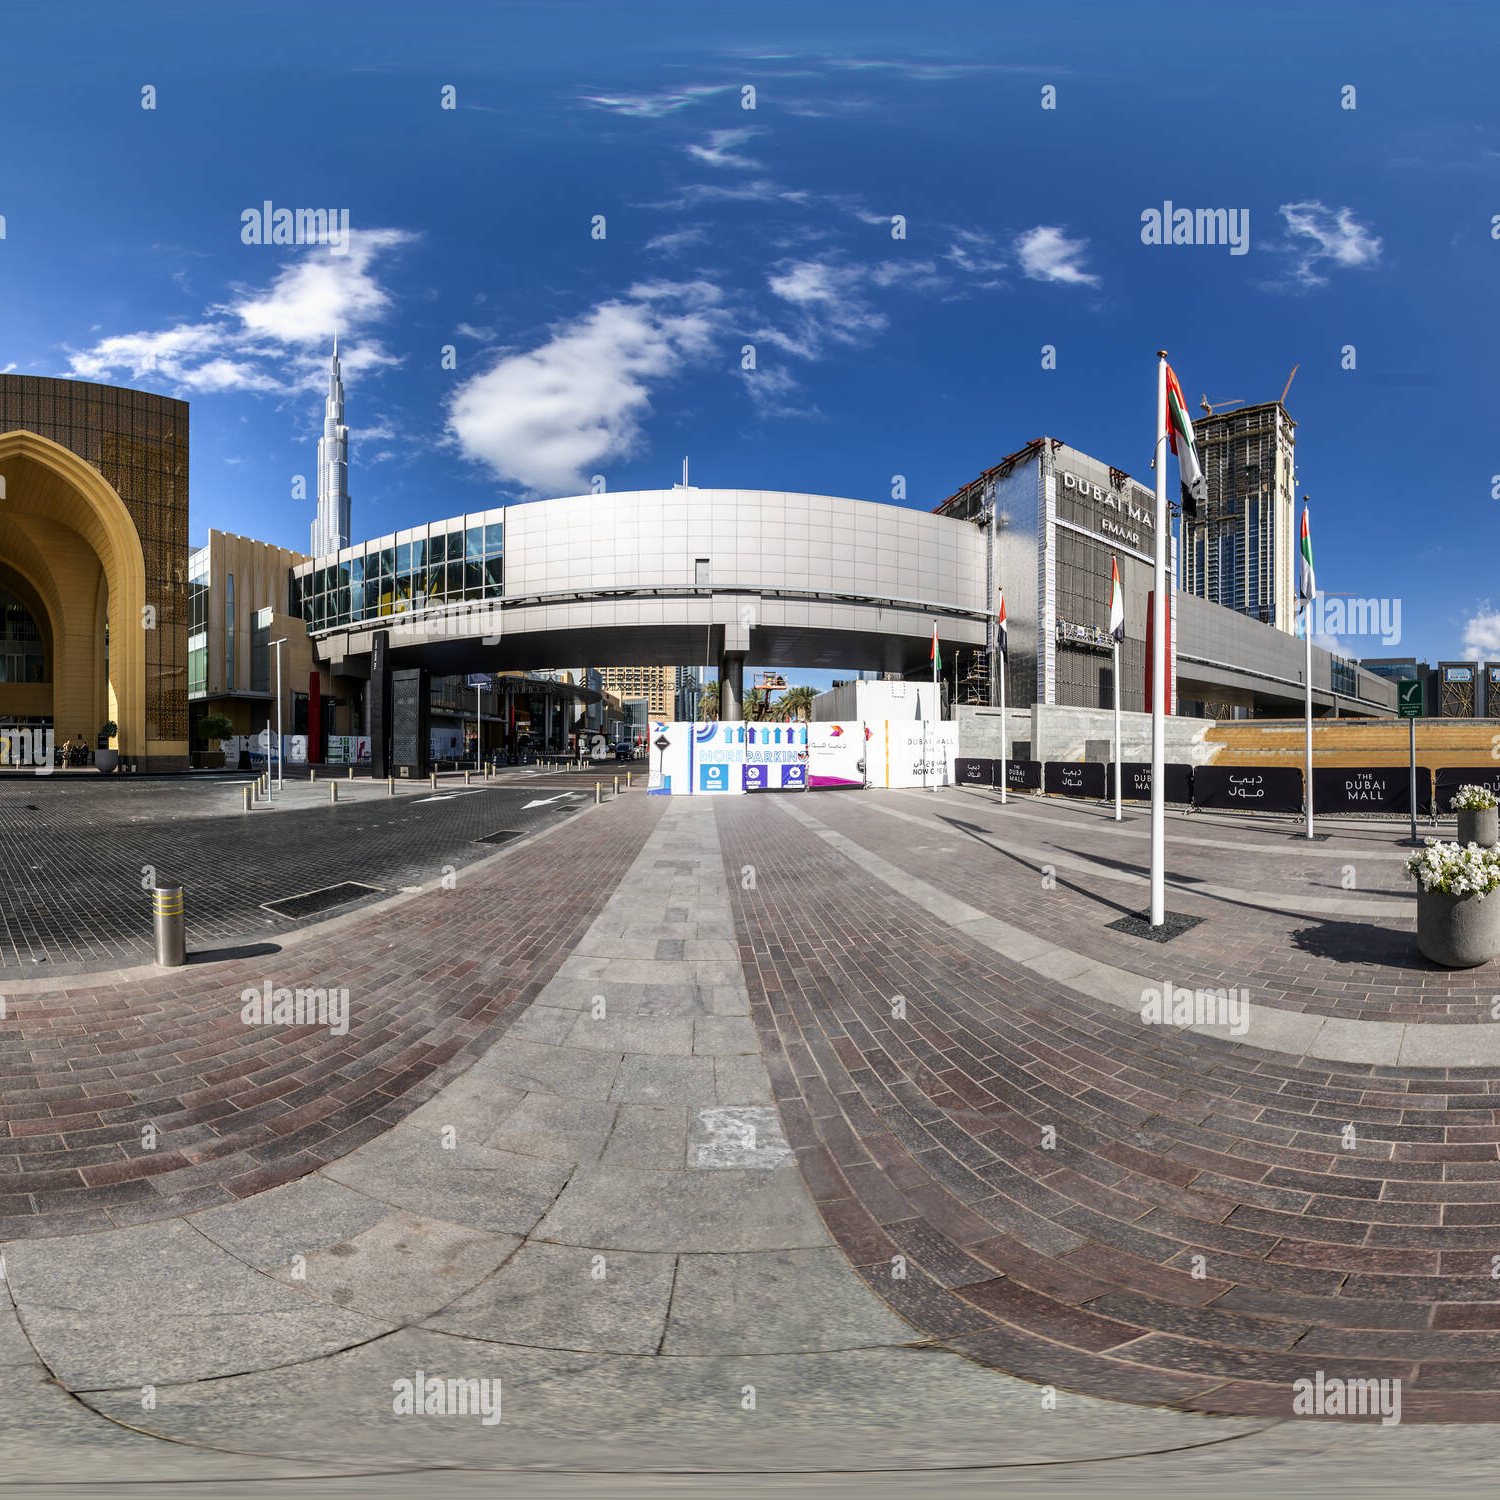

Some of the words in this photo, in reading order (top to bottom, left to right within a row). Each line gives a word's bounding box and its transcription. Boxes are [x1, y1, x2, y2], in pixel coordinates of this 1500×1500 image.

[1063, 471, 1122, 512] DUBAI
[1128, 501, 1155, 530] MA
[1102, 518, 1140, 544] EMAAR
[700, 750, 743, 762] MORE
[1008, 769, 1025, 777] DUBAI
[1062, 768, 1082, 776] دبي
[1062, 778, 1083, 787] مول
[1229, 774, 1263, 784] دبي
[1345, 780, 1386, 791] DUBAI
[1228, 785, 1265, 798] مول
[1348, 791, 1384, 800] MALL
